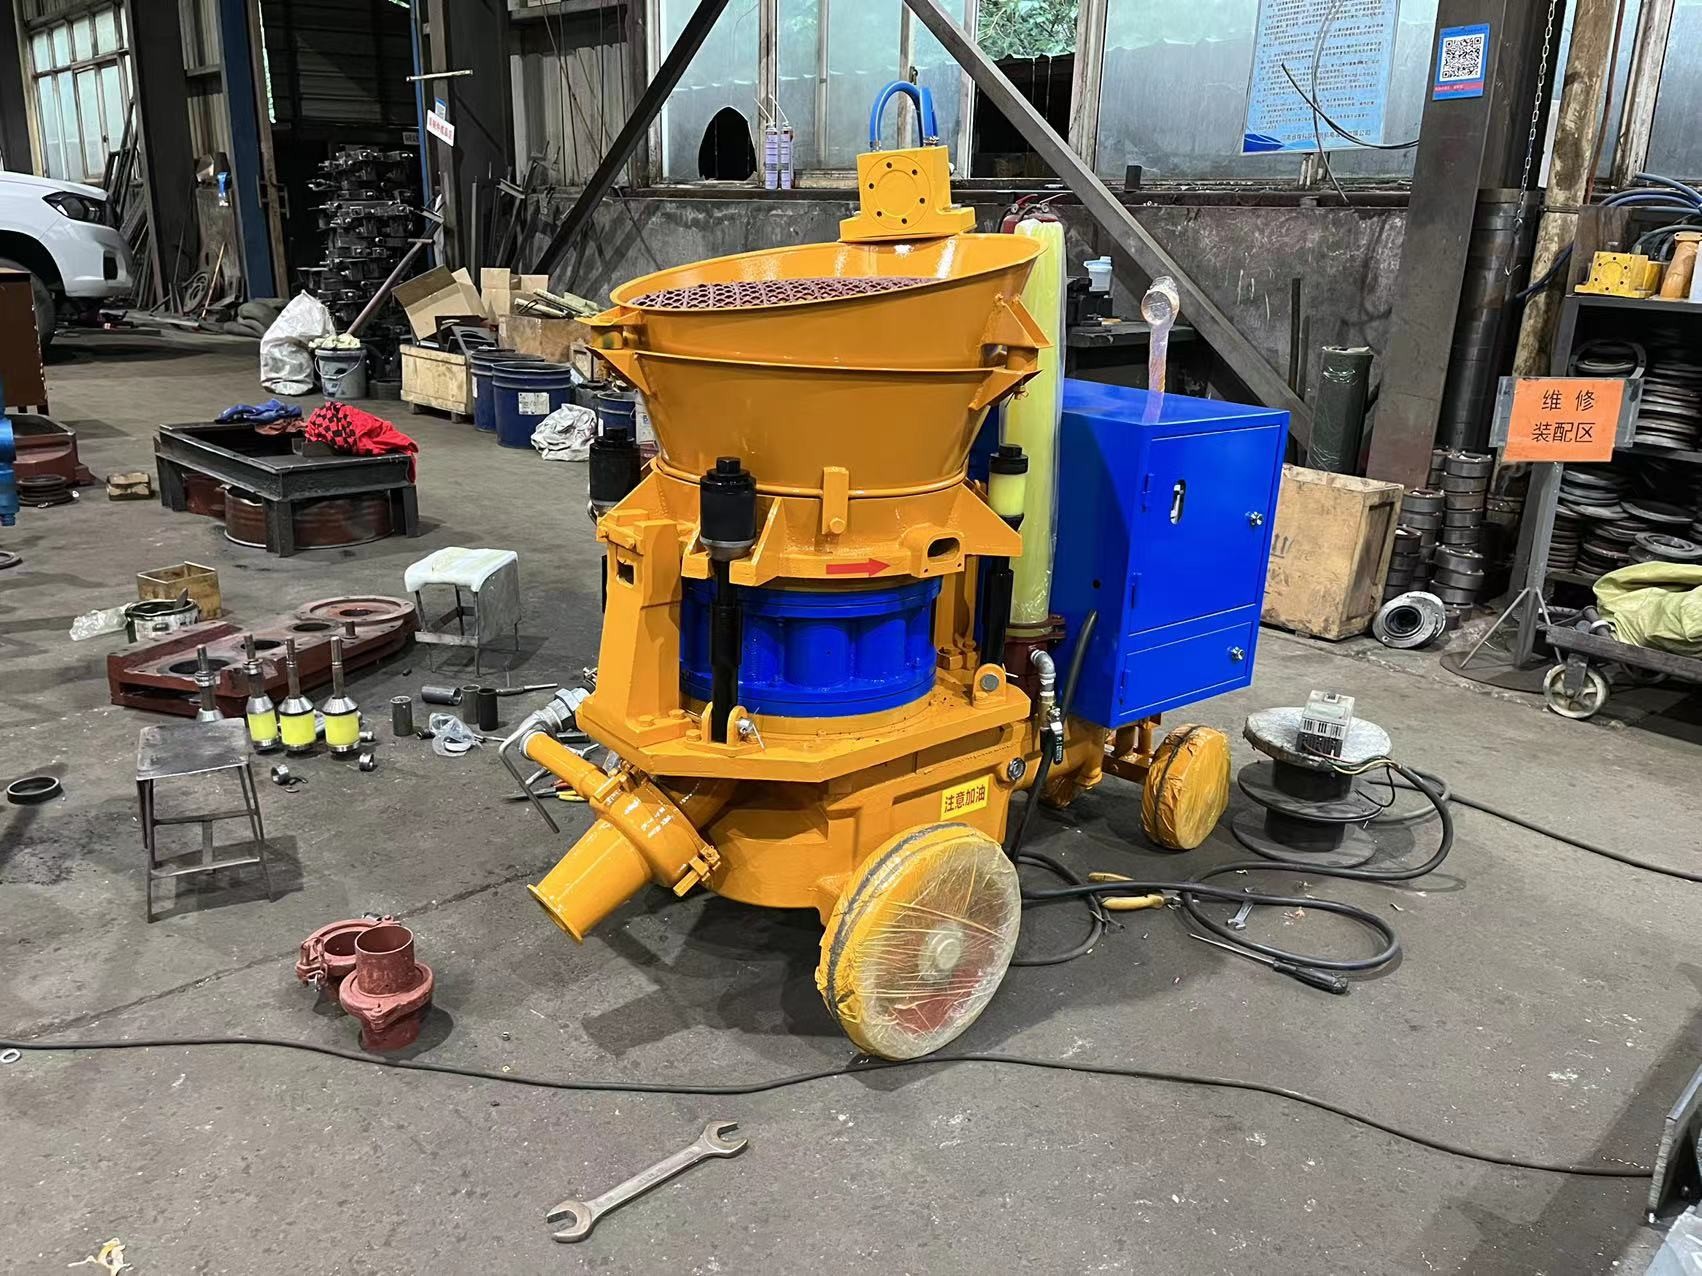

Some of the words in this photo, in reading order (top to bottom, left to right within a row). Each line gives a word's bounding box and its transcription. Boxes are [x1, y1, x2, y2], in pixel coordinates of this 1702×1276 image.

[1542, 389, 1595, 412] 维修
[1532, 421, 1596, 443] 装配区
[944, 784, 986, 813] 注意加油
